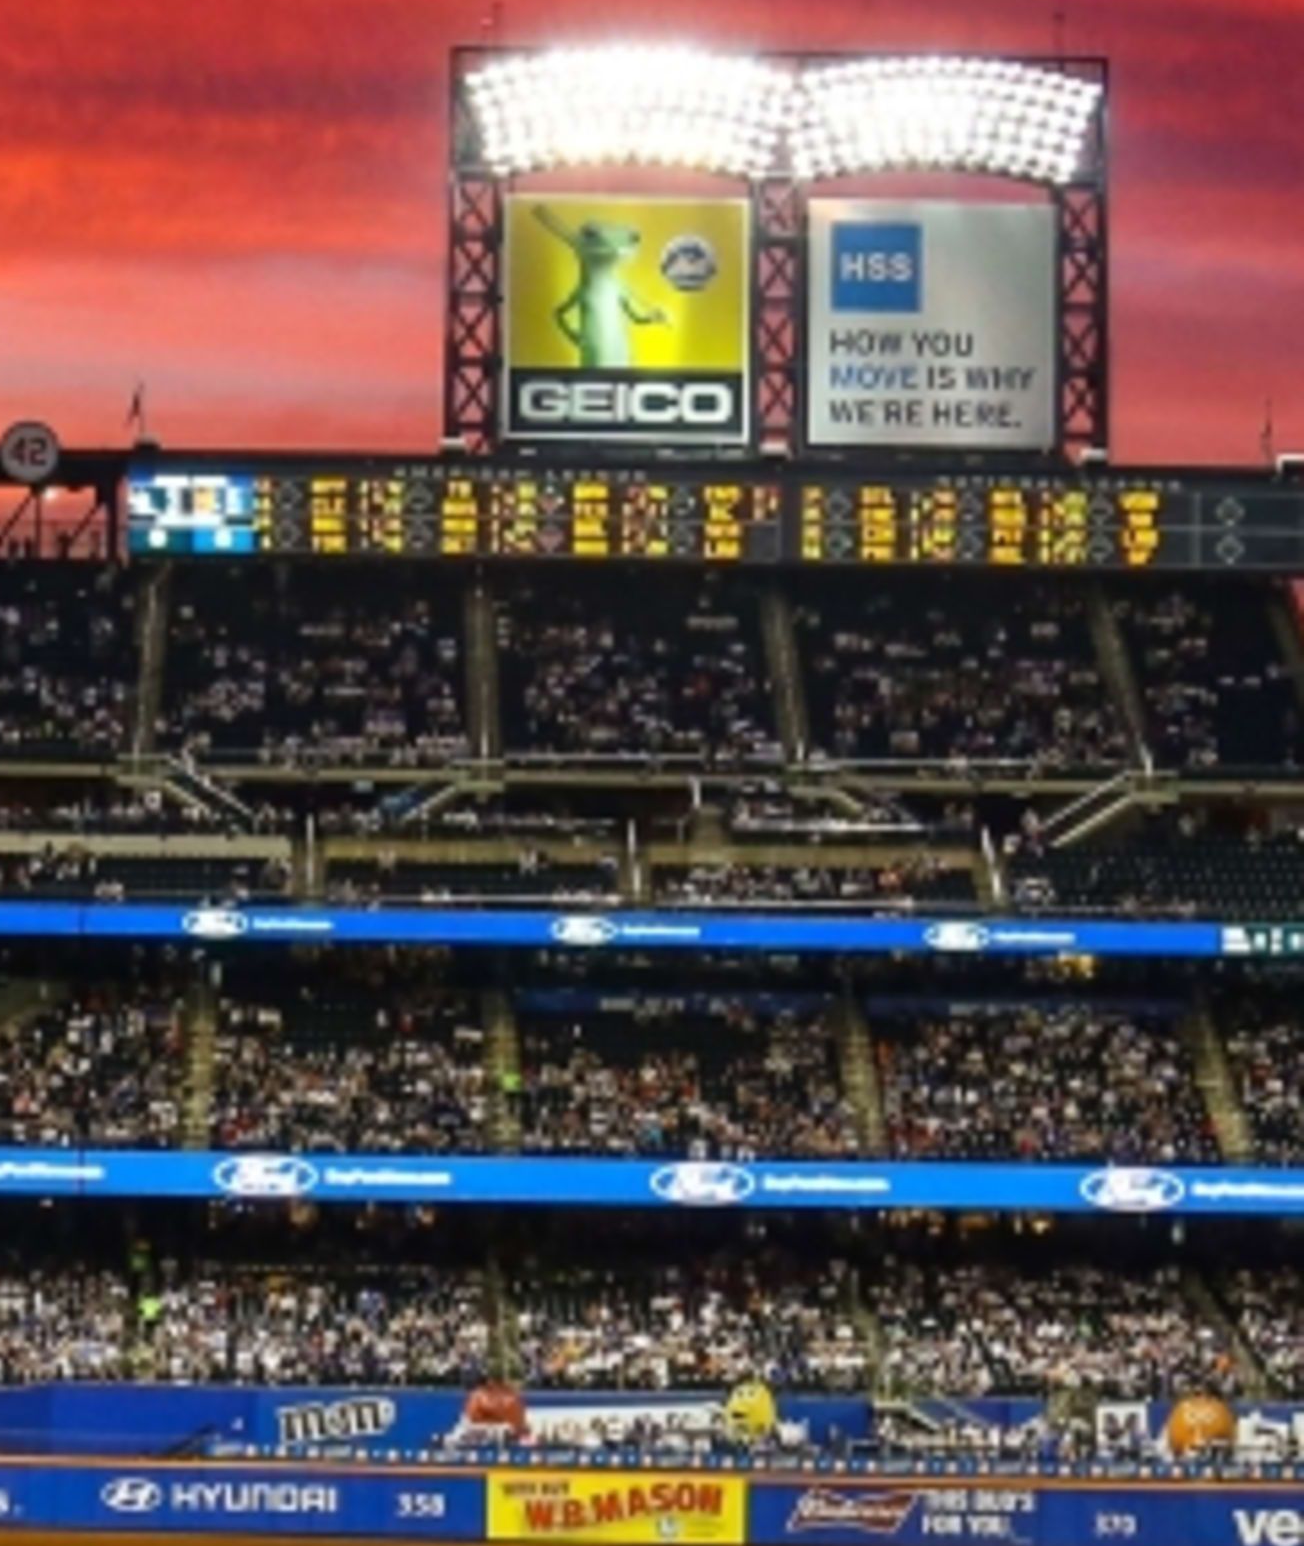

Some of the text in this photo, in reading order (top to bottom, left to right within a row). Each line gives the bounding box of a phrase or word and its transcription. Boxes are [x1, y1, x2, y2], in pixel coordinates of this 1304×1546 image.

[840, 253, 913, 282] HSS
[829, 328, 974, 357] HOW YOU
[829, 363, 1037, 392] MOVE IS WHY
[519, 379, 734, 423] GEICO
[931, 400, 1023, 429] HERE.
[10, 436, 48, 467] 42
[170, 1481, 339, 1514] HYUNDAI
